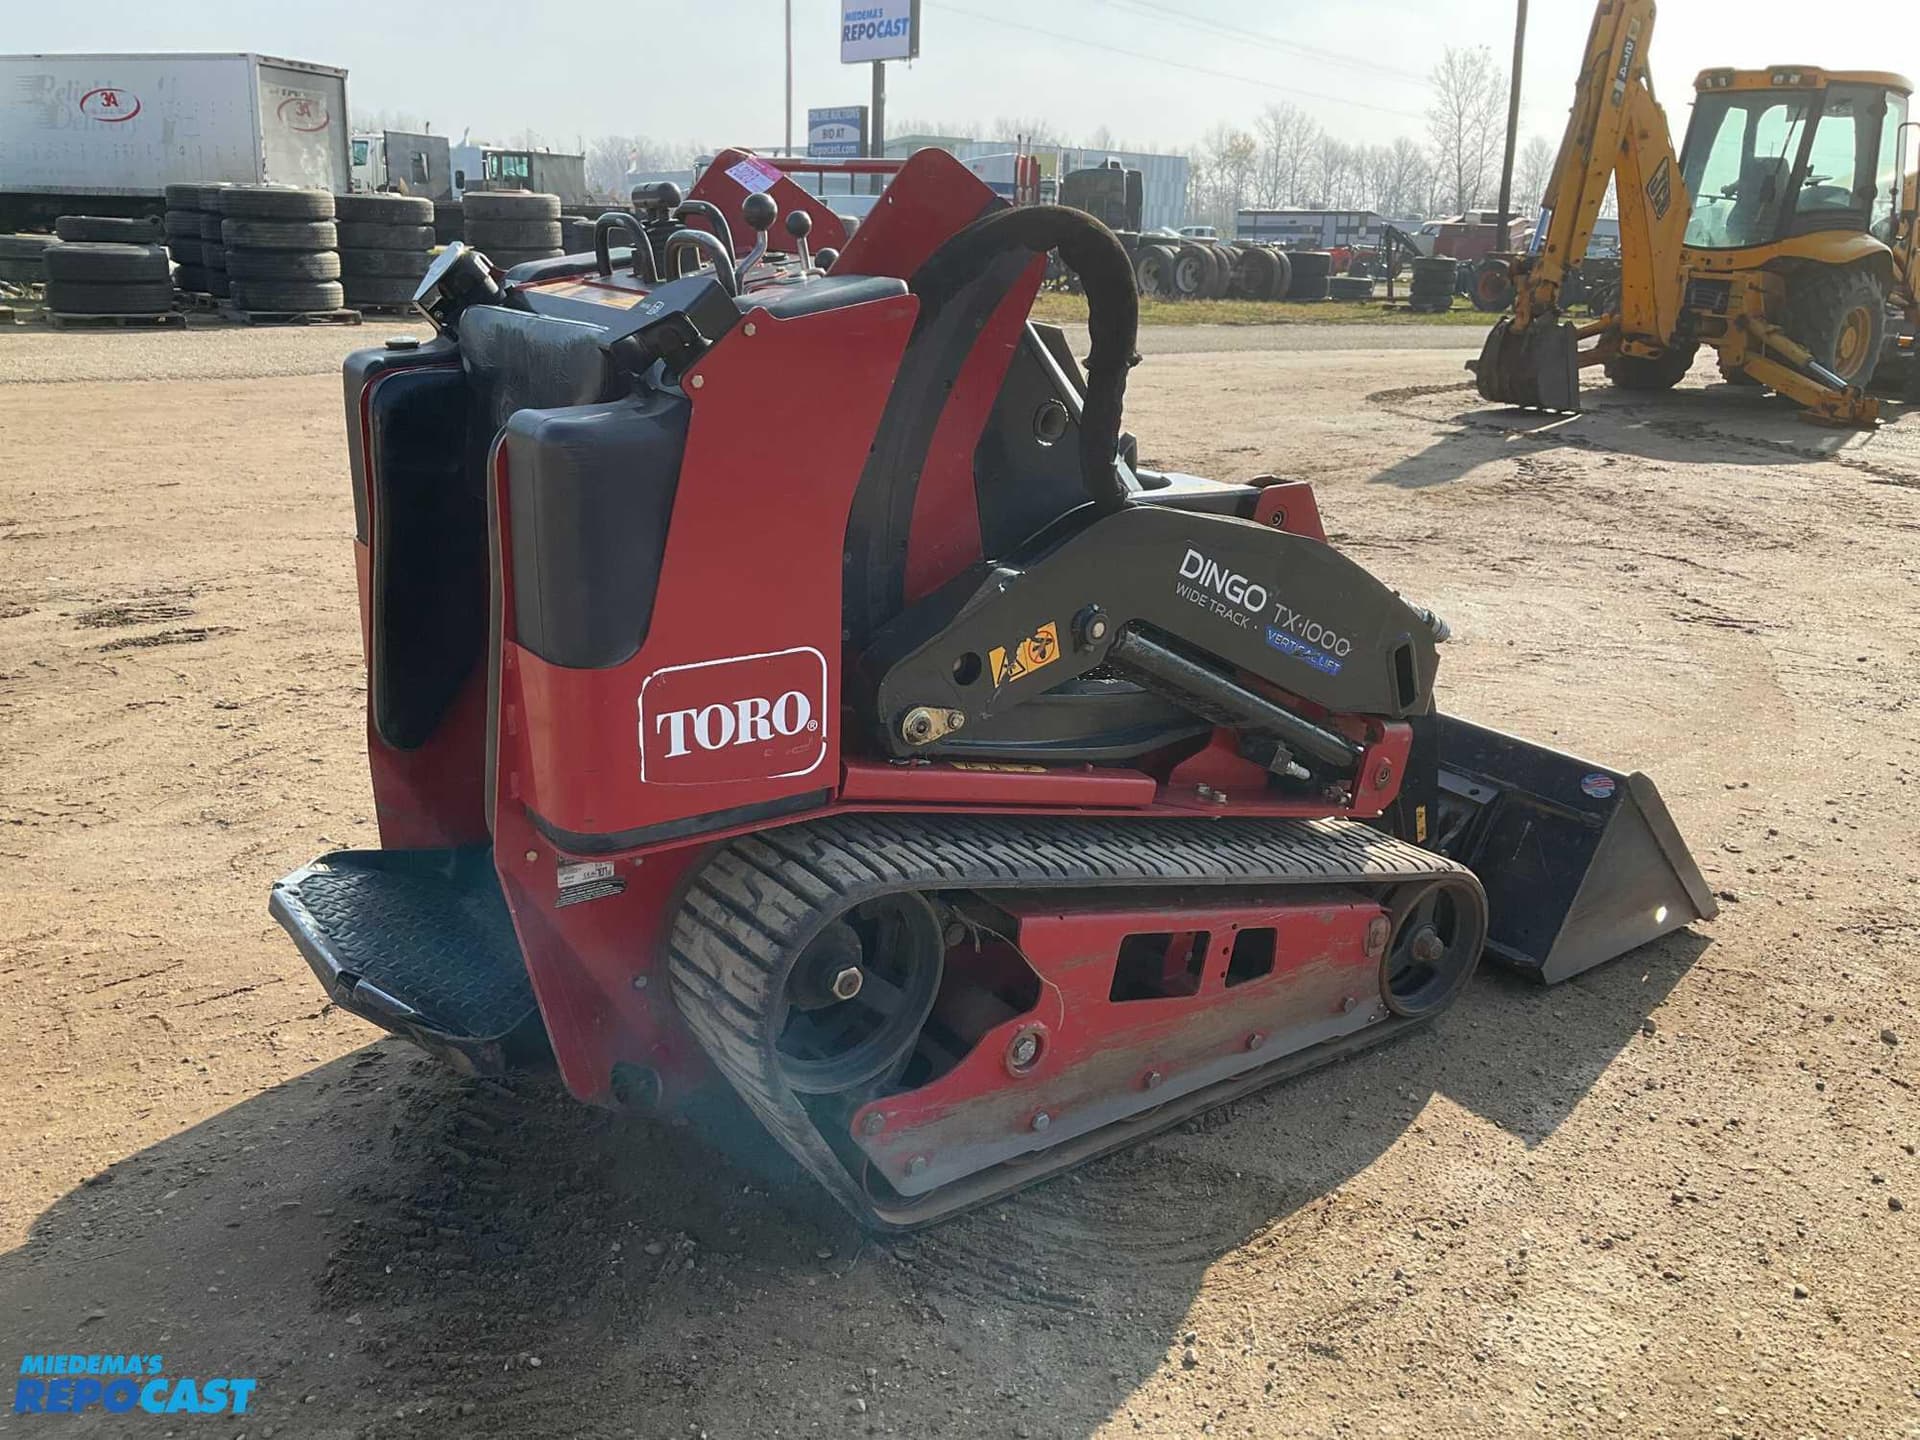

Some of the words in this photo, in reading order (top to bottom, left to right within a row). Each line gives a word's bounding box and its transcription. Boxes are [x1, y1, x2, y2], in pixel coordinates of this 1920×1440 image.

[843, 16, 909, 42] REPOCAST
[100, 92, 119, 107] 3A
[822, 128, 835, 139] BID
[836, 127, 845, 138] AT
[1179, 548, 1267, 612] DINGO
[1176, 581, 1209, 608] WIDE
[1209, 598, 1251, 630] TRACK
